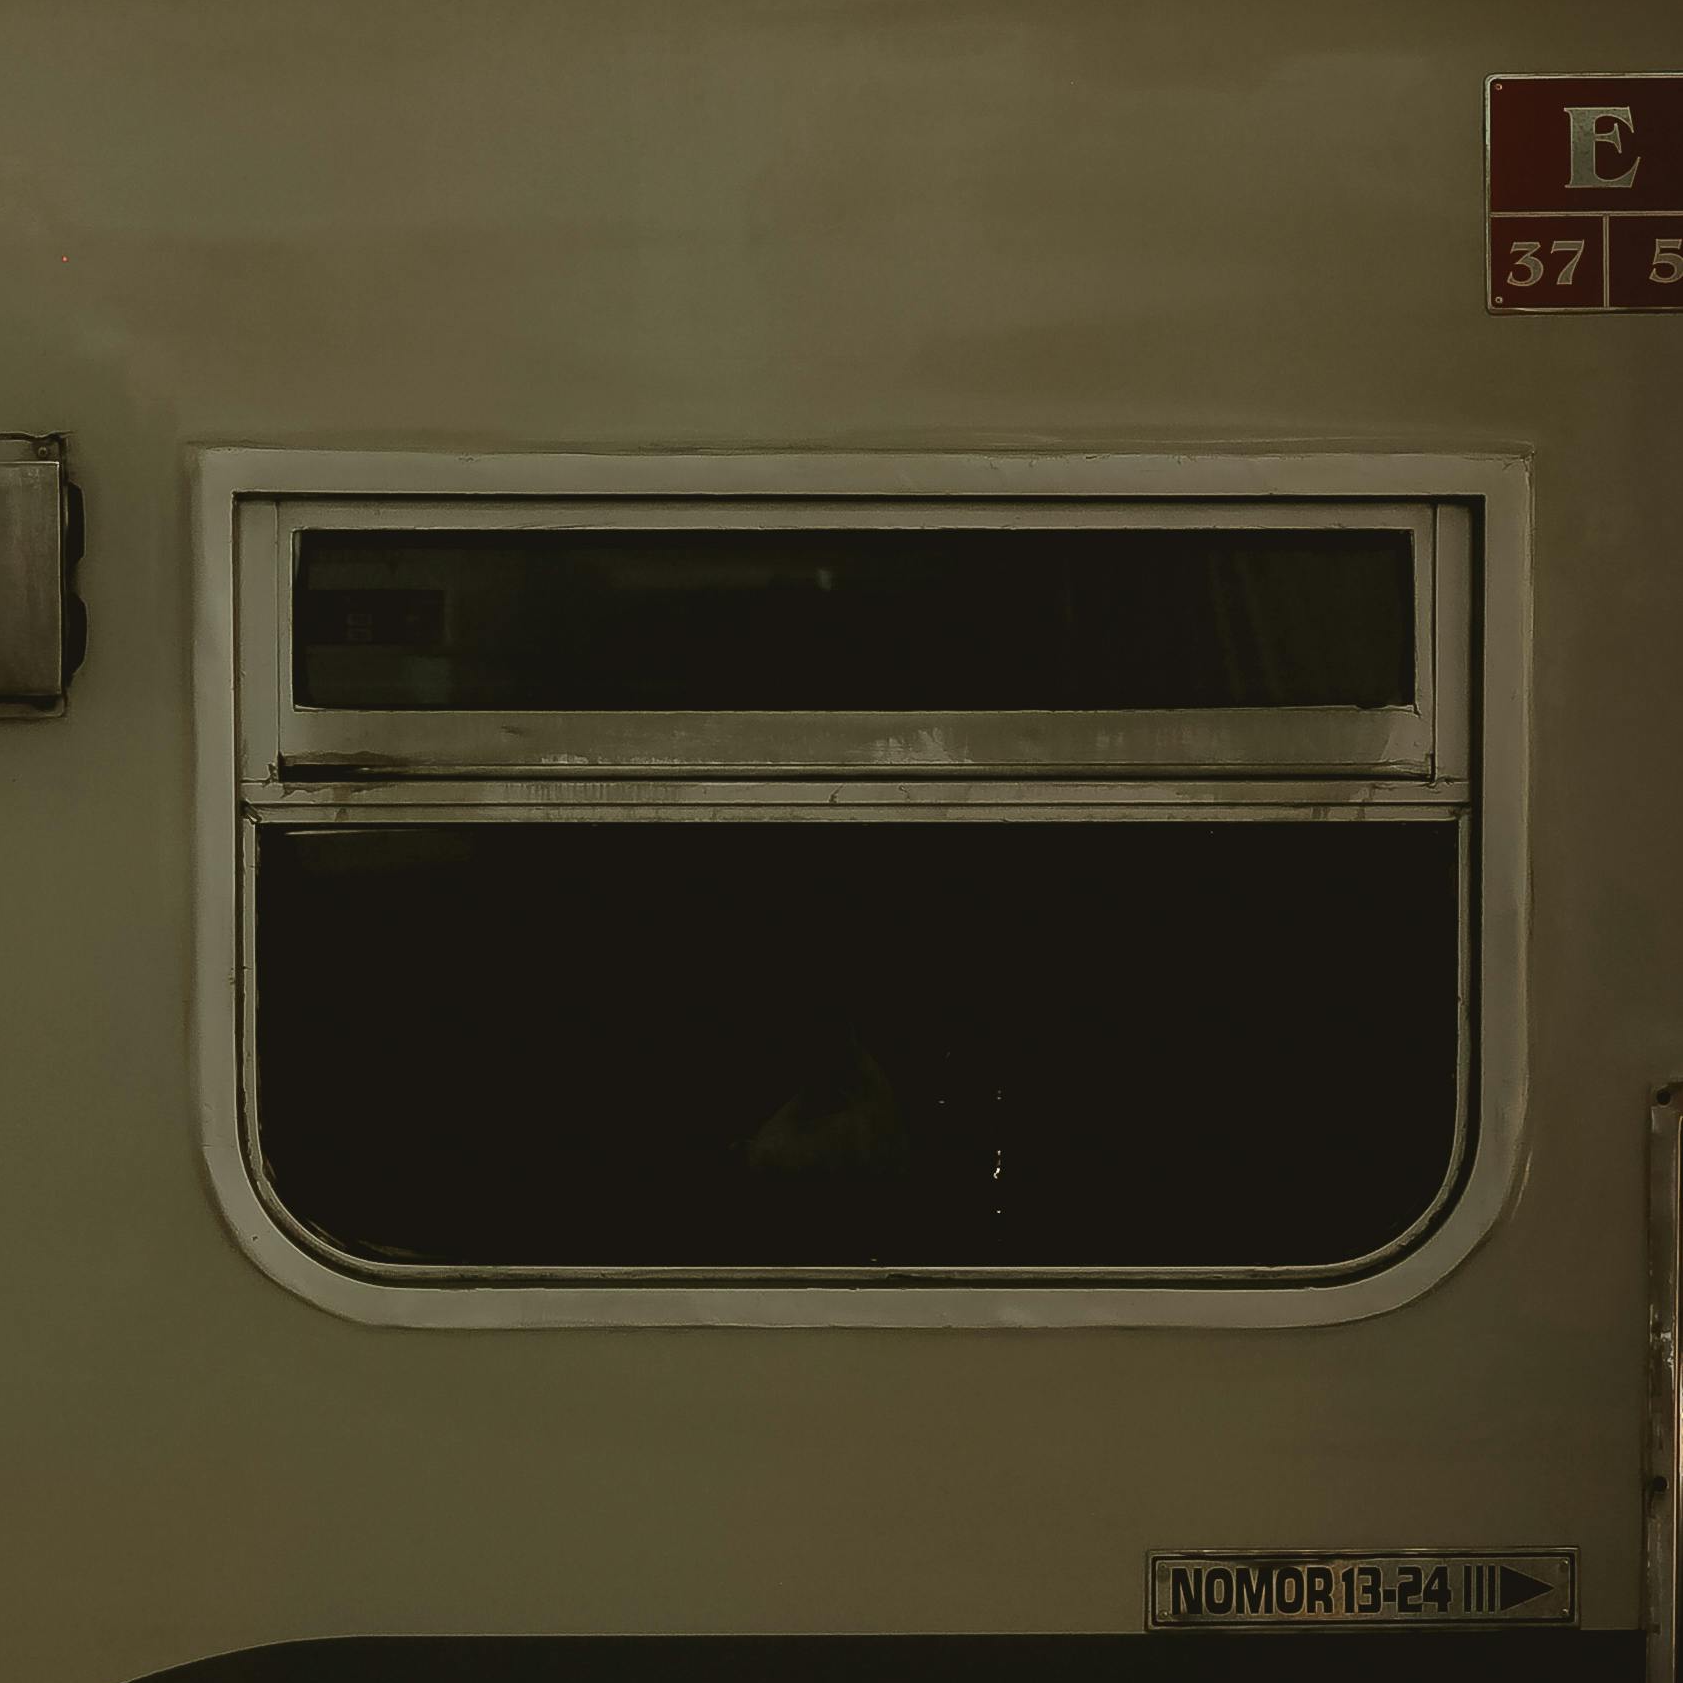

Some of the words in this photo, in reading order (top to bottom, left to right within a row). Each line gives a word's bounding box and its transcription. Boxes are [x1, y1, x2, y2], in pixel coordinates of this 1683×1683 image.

[1563, 106, 1641, 188] E
[1506, 239, 1585, 286] 37
[1648, 238, 1683, 283] 5
[1170, 1565, 1335, 1615] NOMOR
[1341, 1564, 1452, 1614] 13-24
